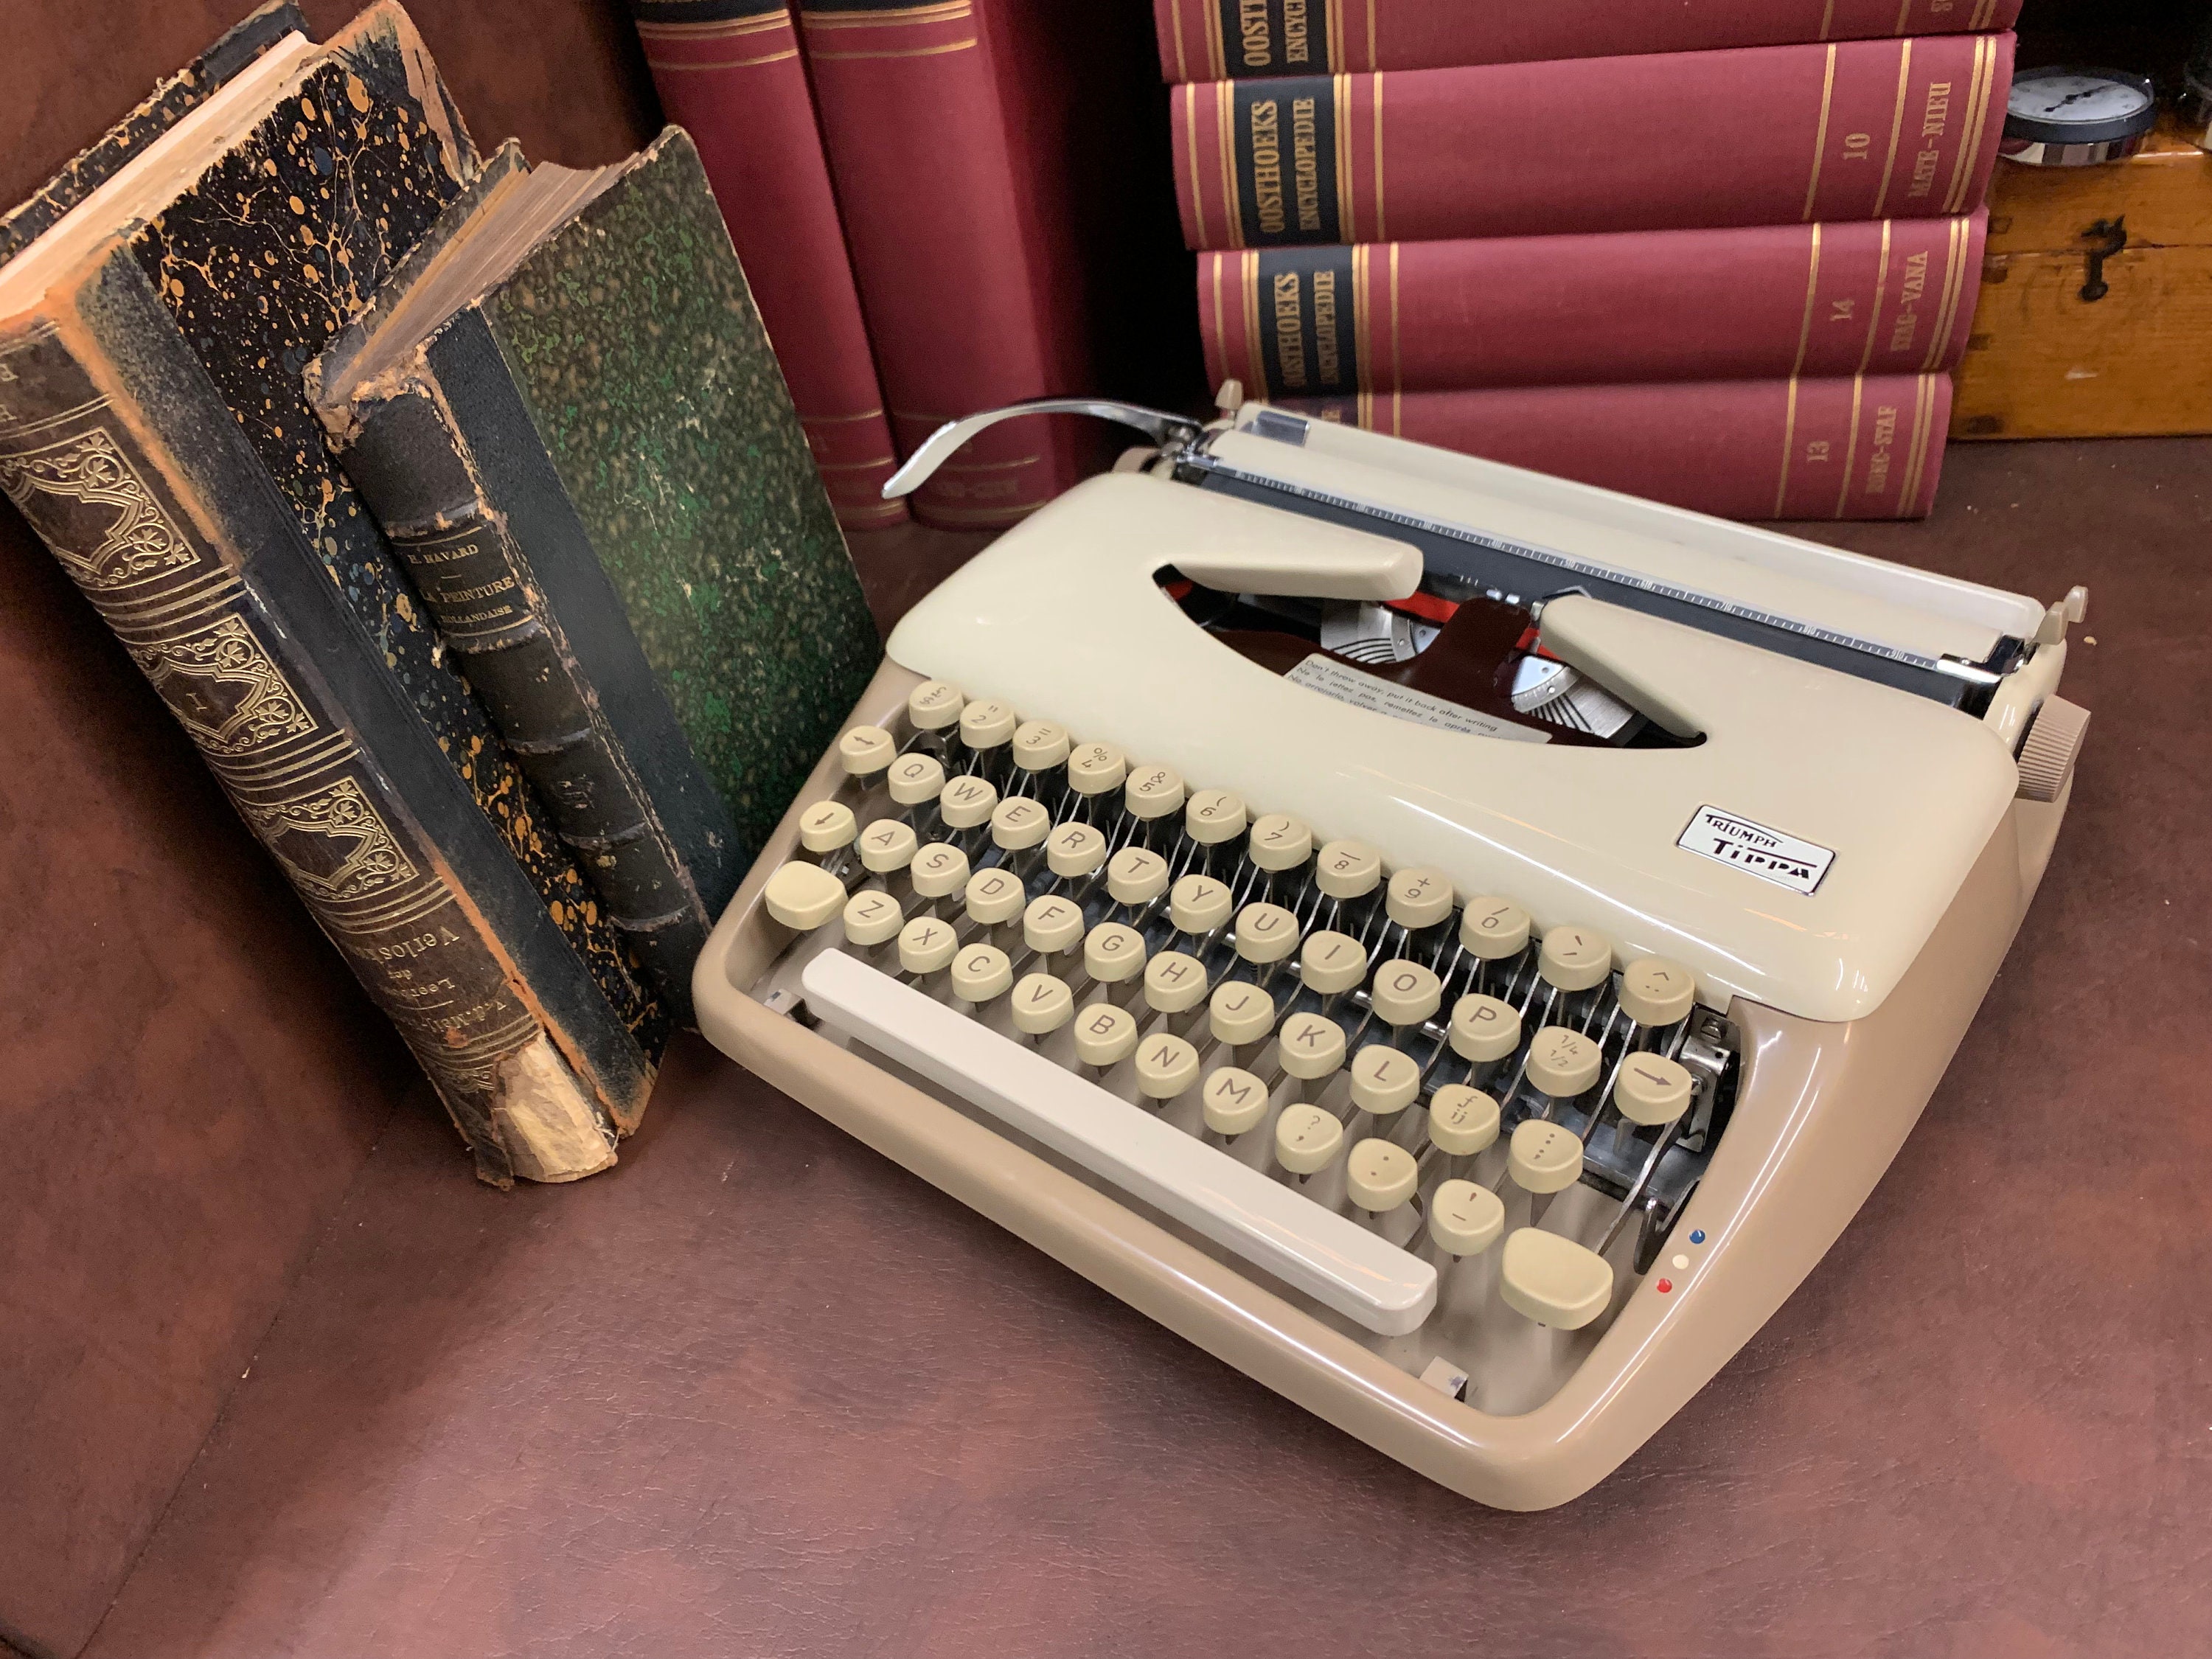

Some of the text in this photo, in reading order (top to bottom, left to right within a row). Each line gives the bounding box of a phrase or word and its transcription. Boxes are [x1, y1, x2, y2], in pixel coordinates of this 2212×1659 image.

[1843, 133, 1870, 160] 10
[1251, 100, 1284, 233] OOSTHOEKS
[1293, 97, 1321, 230] ENCYCLOPEDIE
[1807, 441, 1829, 462] 13
[423, 544, 479, 563] HAVARD
[440, 577, 515, 602] PEINTURE
[1306, 660, 1329, 672] Don't
[1331, 670, 1356, 684] throw
[1358, 681, 1385, 695] away,
[1387, 691, 1404, 700] put
[1415, 700, 1436, 712] back
[1439, 709, 1462, 720] after
[1465, 717, 1498, 732] writing
[1384, 701, 1422, 717] remettez
[971, 715, 987, 723] 2
[1026, 735, 1041, 745] 3
[903, 763, 925, 778] Q
[953, 782, 984, 801] W
[1139, 782, 1154, 793] 5
[1005, 806, 1031, 822] E
[1200, 807, 1217, 817] 6
[872, 831, 895, 846] A
[1061, 831, 1085, 849] R
[1264, 832, 1284, 841] 7
[1705, 814, 1781, 848] TRIUMPH
[925, 854, 950, 869] S
[1127, 857, 1150, 874] T
[1334, 860, 1349, 870] 8
[980, 877, 1005, 894] D
[1192, 885, 1214, 902] Y
[1405, 888, 1422, 899] 9
[858, 900, 885, 918] Z
[1037, 905, 1065, 920] F
[1253, 913, 1280, 931] U
[912, 928, 938, 946] X
[1102, 935, 1124, 951] G
[1324, 945, 1341, 960] I
[967, 956, 990, 972] C
[1160, 961, 1188, 983] H
[1393, 973, 1417, 992] O
[1031, 984, 1053, 1002] V
[1225, 995, 1250, 1012] J
[1469, 1005, 1497, 1023] P
[1089, 1015, 1116, 1034] B
[1296, 1024, 1326, 1047] K
[1150, 1046, 1180, 1068] N
[1374, 1060, 1391, 1082] L
[1216, 1078, 1251, 1105] M
